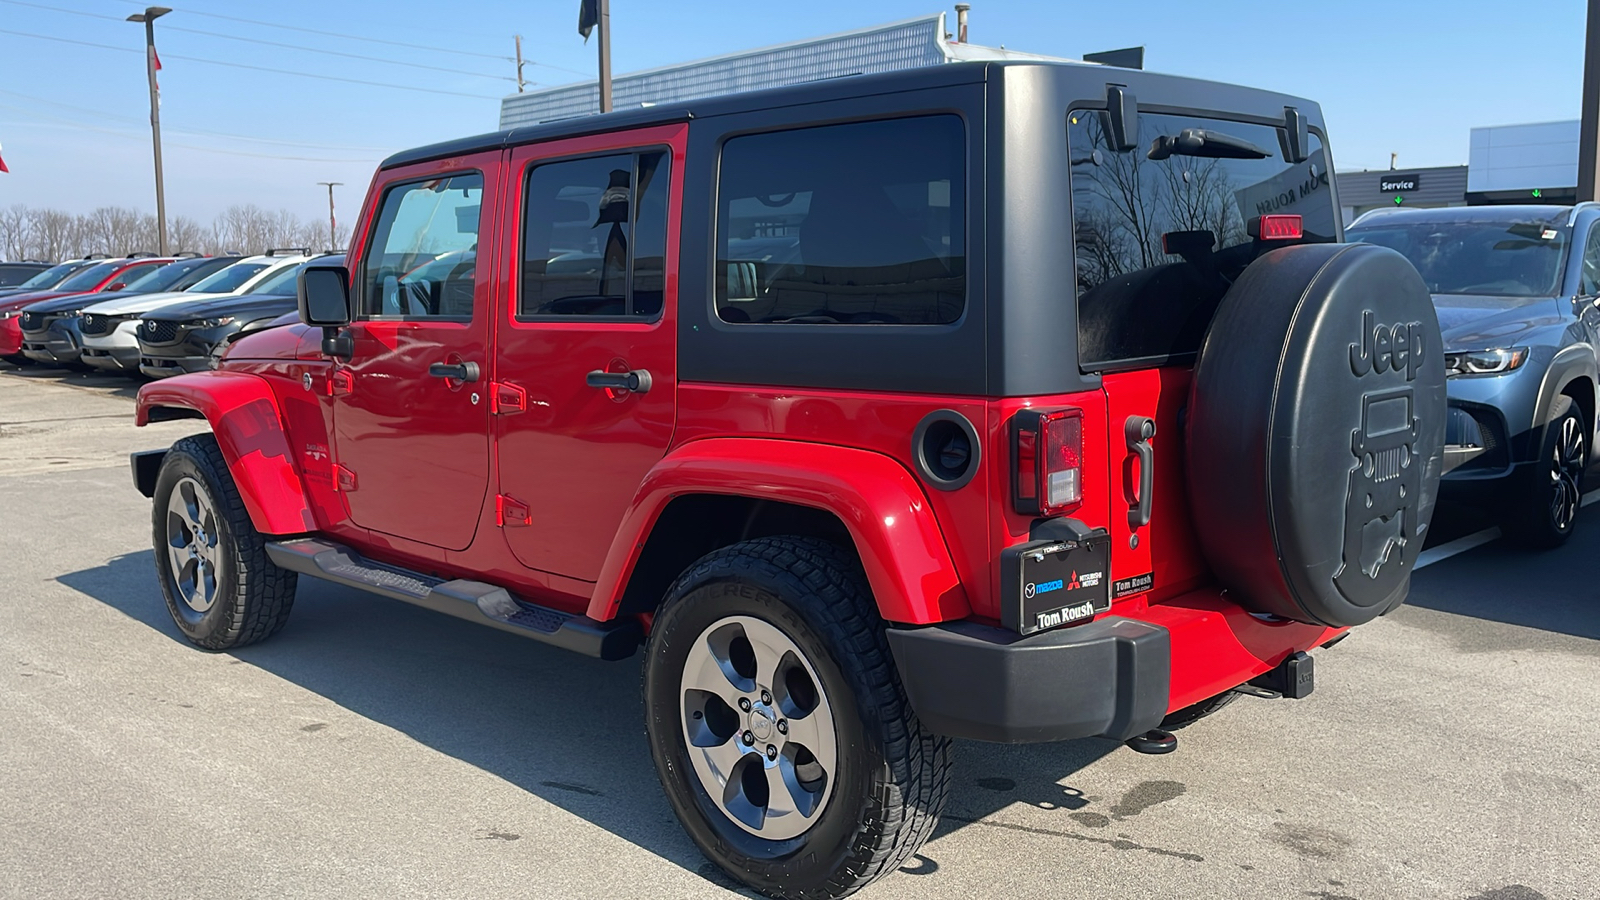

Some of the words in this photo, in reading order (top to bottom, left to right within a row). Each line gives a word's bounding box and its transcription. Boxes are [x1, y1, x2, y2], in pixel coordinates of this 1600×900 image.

[1382, 181, 1414, 190] Service
[1348, 309, 1426, 382] Jeep
[1116, 582, 1131, 592] Tom
[1132, 574, 1152, 588] Roush
[1037, 611, 1061, 628] Tom
[1062, 601, 1094, 623] Roush
